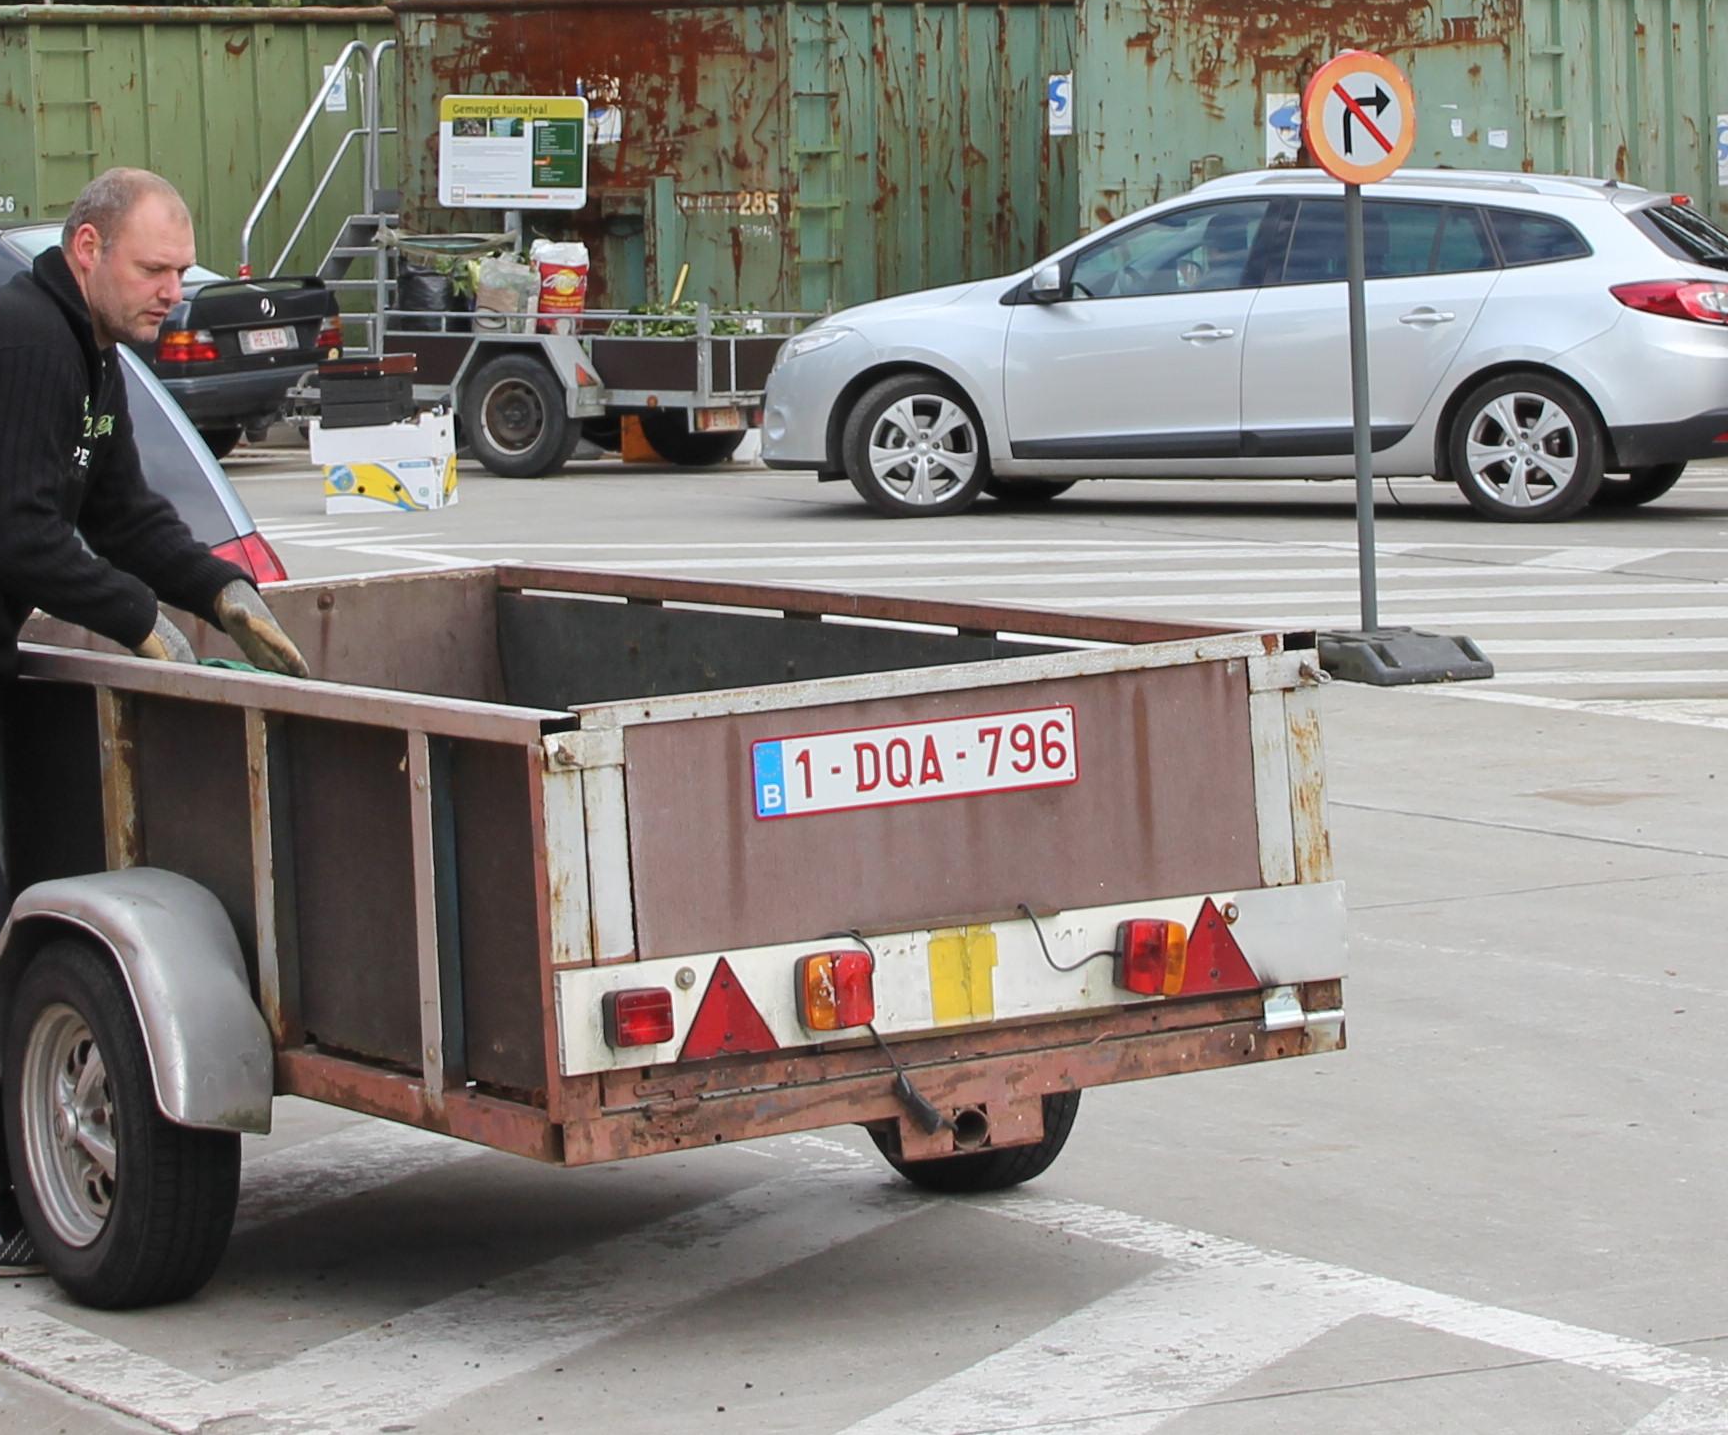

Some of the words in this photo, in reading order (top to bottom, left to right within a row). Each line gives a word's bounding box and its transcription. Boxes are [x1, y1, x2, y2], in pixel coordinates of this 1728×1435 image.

[452, 103, 499, 117] Gemengd
[503, 103, 548, 117] tuinafval
[736, 189, 780, 216] 285
[794, 719, 1068, 799] 1-DQA-796
[762, 783, 782, 809] B
